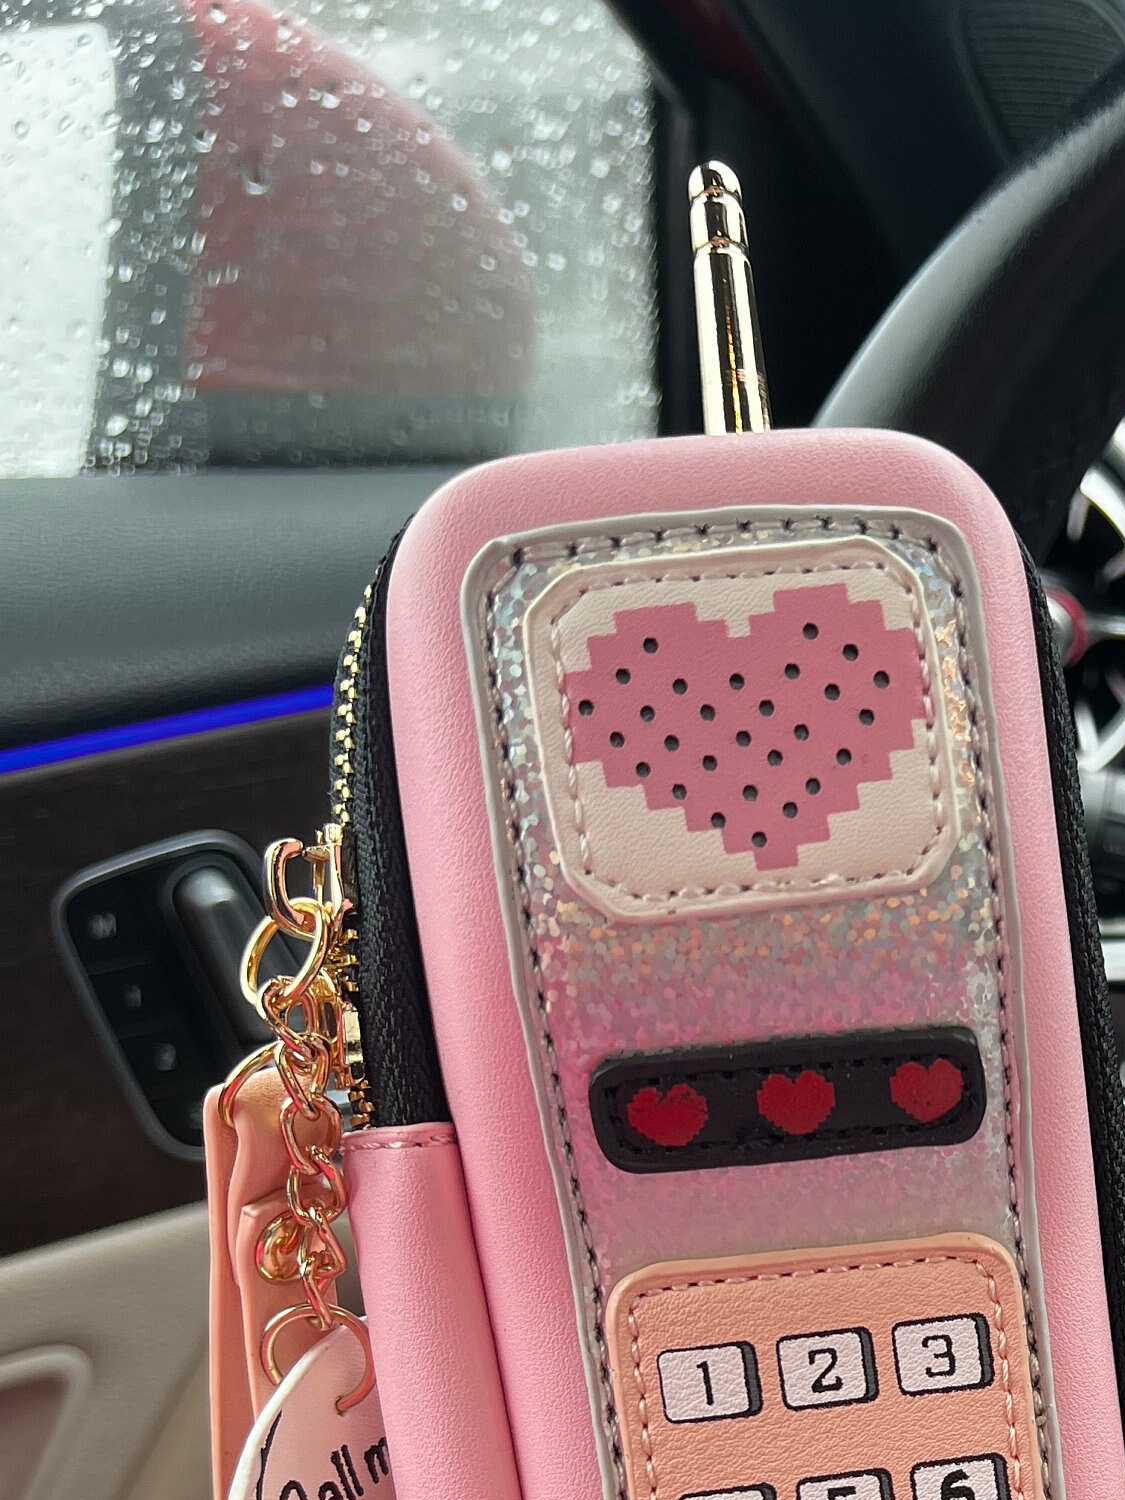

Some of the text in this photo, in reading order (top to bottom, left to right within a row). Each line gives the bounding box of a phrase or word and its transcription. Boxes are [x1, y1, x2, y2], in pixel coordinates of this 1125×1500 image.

[696, 1334, 957, 1406] 1 2 3
